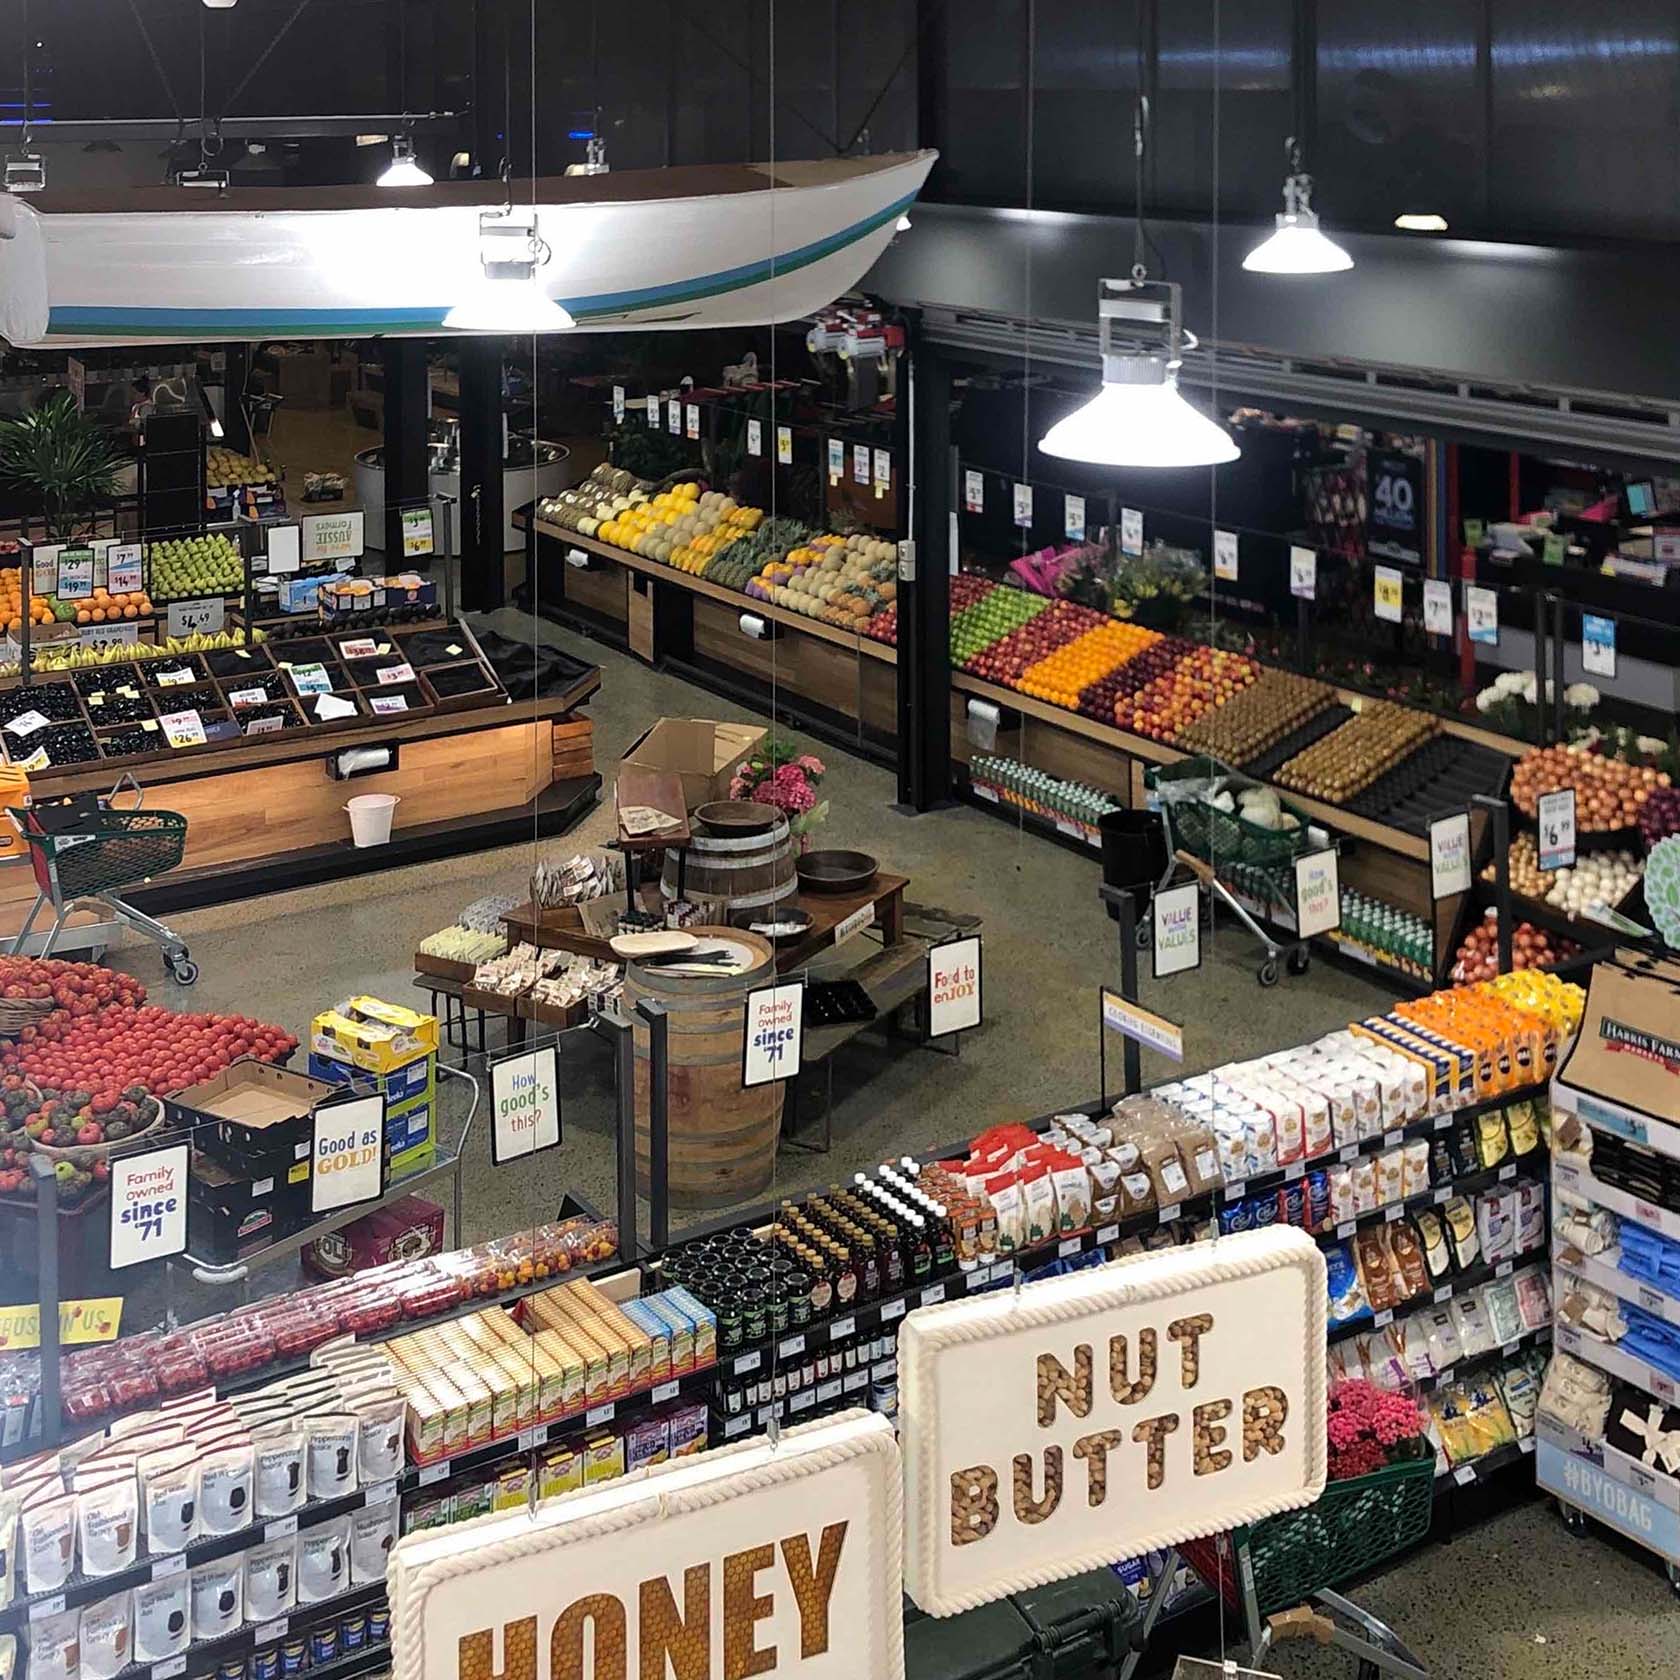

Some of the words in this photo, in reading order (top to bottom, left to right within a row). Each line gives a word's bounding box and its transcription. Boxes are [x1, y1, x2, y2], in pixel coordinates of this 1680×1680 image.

[1375, 475, 1413, 510] 40
[935, 968, 960, 988] Fod
[964, 965, 975, 981] to
[758, 1012, 792, 1027] owned
[759, 1000, 792, 1015] Family
[753, 1027, 794, 1046] since
[512, 1074, 536, 1091] How
[500, 1083, 549, 1118] good's
[511, 1108, 542, 1132] this?
[318, 1130, 355, 1157] Good
[361, 1128, 377, 1145] as
[317, 1147, 377, 1175] GOLD!
[126, 1165, 174, 1186] Family
[126, 1179, 174, 1201] owned
[120, 1197, 177, 1224] since
[1037, 1312, 1214, 1428] NUT
[950, 1386, 1289, 1547] BUTTER
[1564, 1461, 1652, 1531] #BYOBAG
